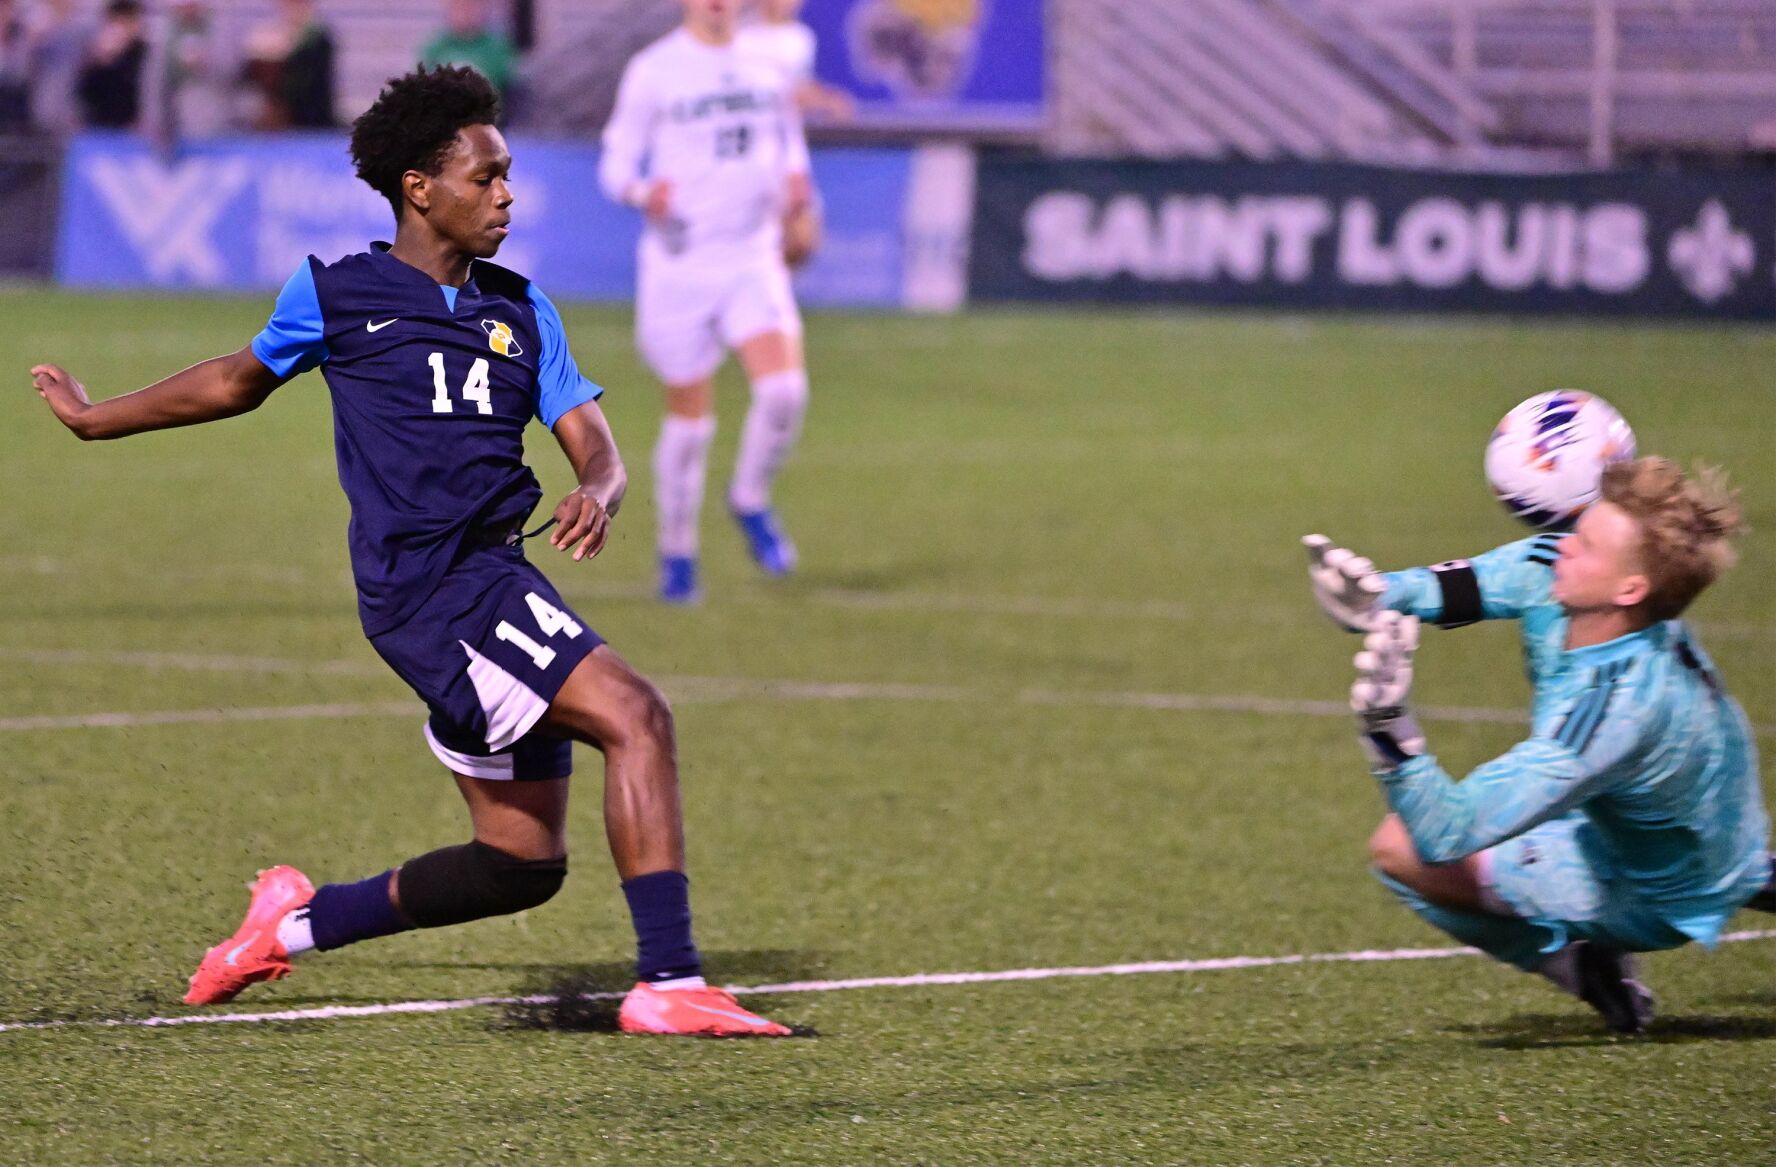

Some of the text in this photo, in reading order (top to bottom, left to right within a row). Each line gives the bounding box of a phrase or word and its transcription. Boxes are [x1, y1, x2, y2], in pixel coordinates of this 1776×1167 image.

[1024, 193, 1650, 293] SAINT LOUIS
[427, 352, 493, 415] 14
[495, 591, 583, 671] 14
